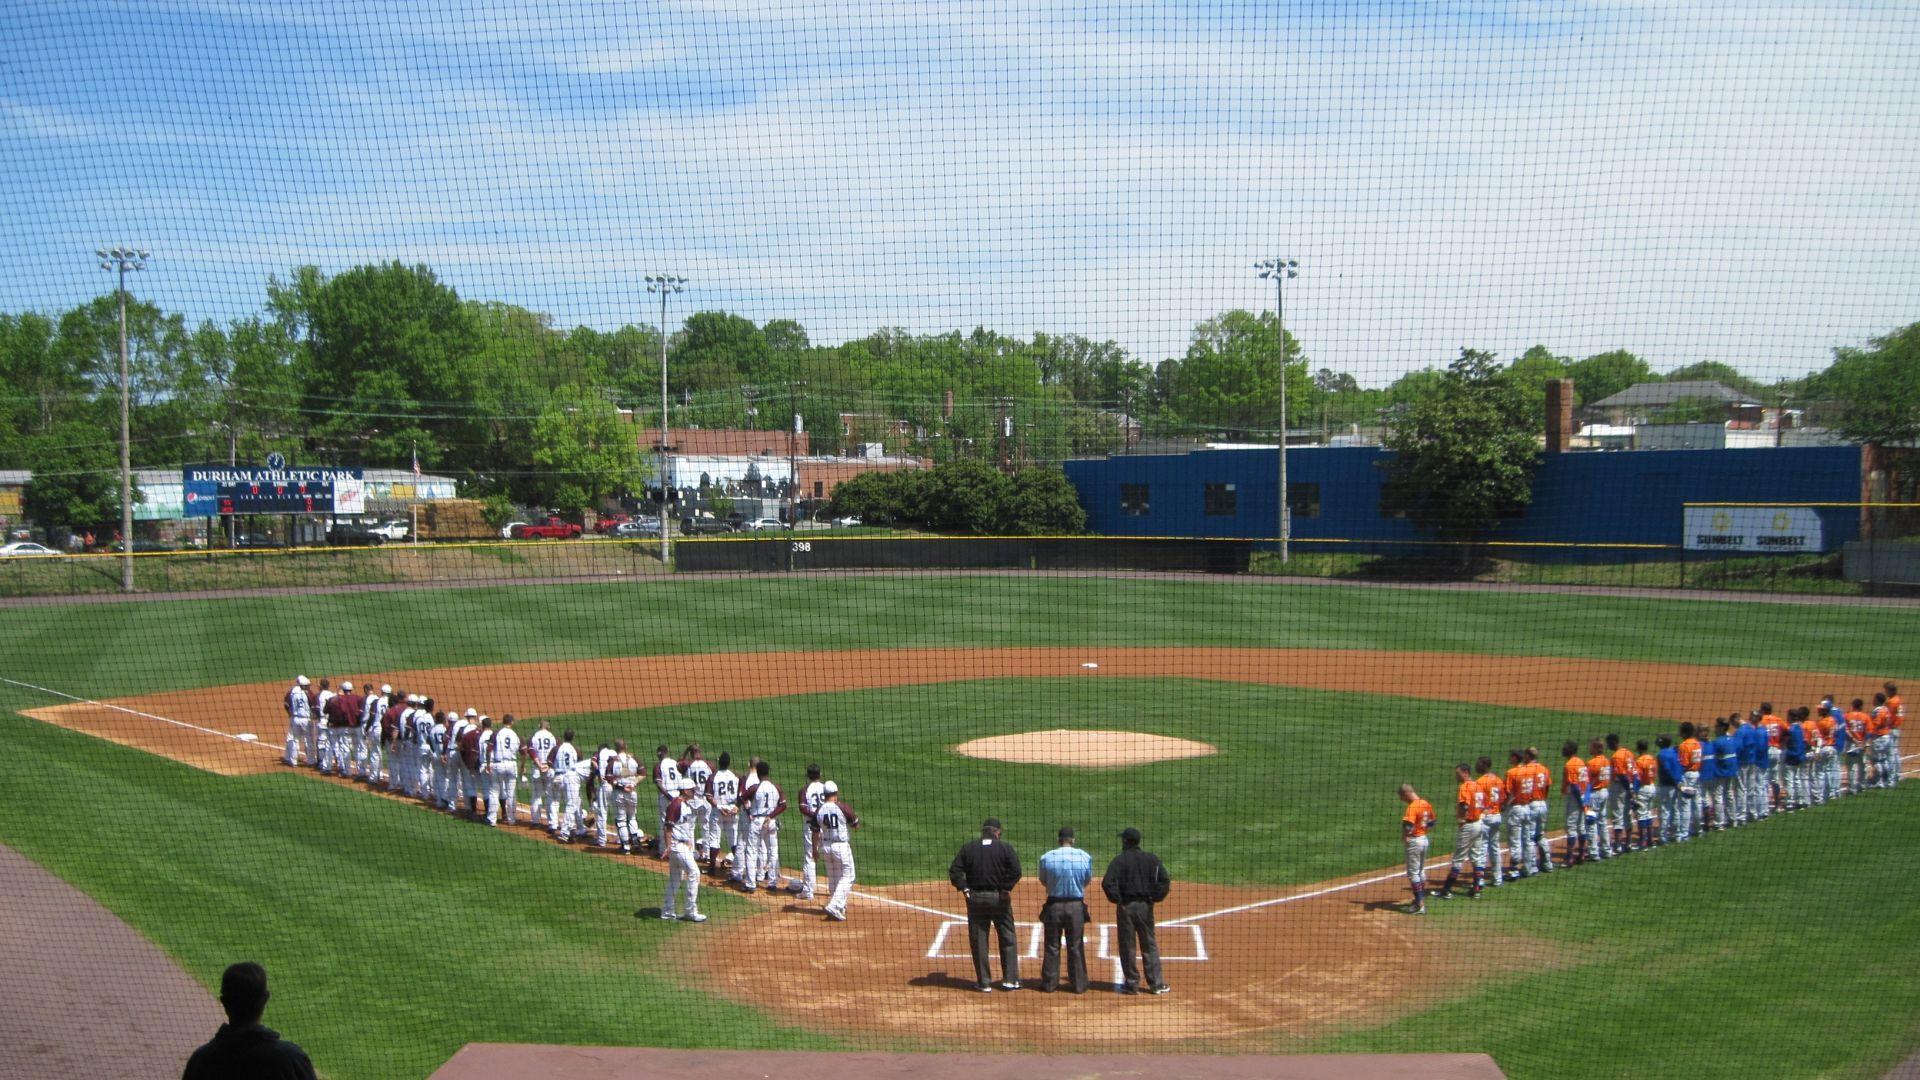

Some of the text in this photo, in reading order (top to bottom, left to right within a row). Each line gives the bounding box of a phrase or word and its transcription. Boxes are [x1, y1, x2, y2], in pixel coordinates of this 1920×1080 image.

[193, 471, 354, 481] DURHAM ATHLETIC PARK
[1696, 535, 1745, 545] SUNBELT
[1756, 536, 1806, 546] SUNBELT
[792, 542, 811, 552] 398
[504, 737, 512, 750] 9
[538, 738, 551, 750] 19
[669, 767, 676, 781] 6
[693, 771, 707, 785] 16
[718, 780, 735, 796] 24
[1489, 787, 1500, 802] 5
[764, 793, 770, 809] 1
[823, 813, 839, 829] 40
